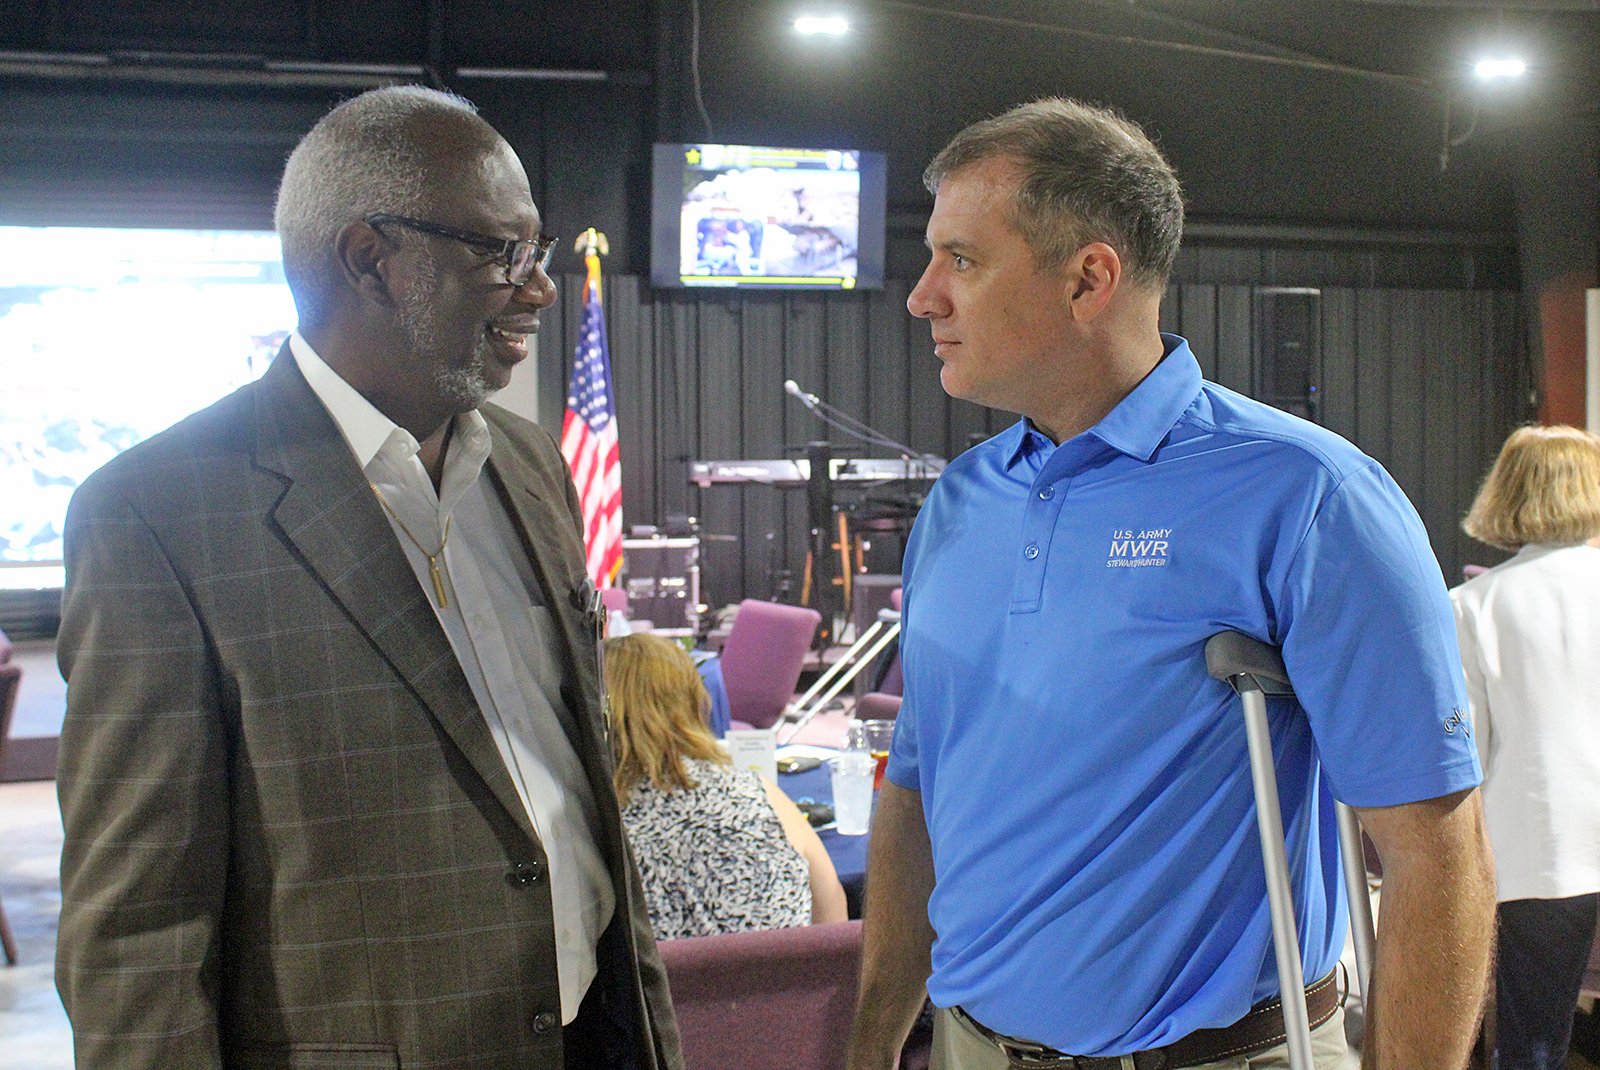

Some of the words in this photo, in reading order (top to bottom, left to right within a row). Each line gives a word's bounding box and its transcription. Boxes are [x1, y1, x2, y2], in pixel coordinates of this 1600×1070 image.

[1113, 530, 1135, 539] U.S.
[1137, 529, 1172, 539] ARMY
[1108, 540, 1169, 557] MWR
